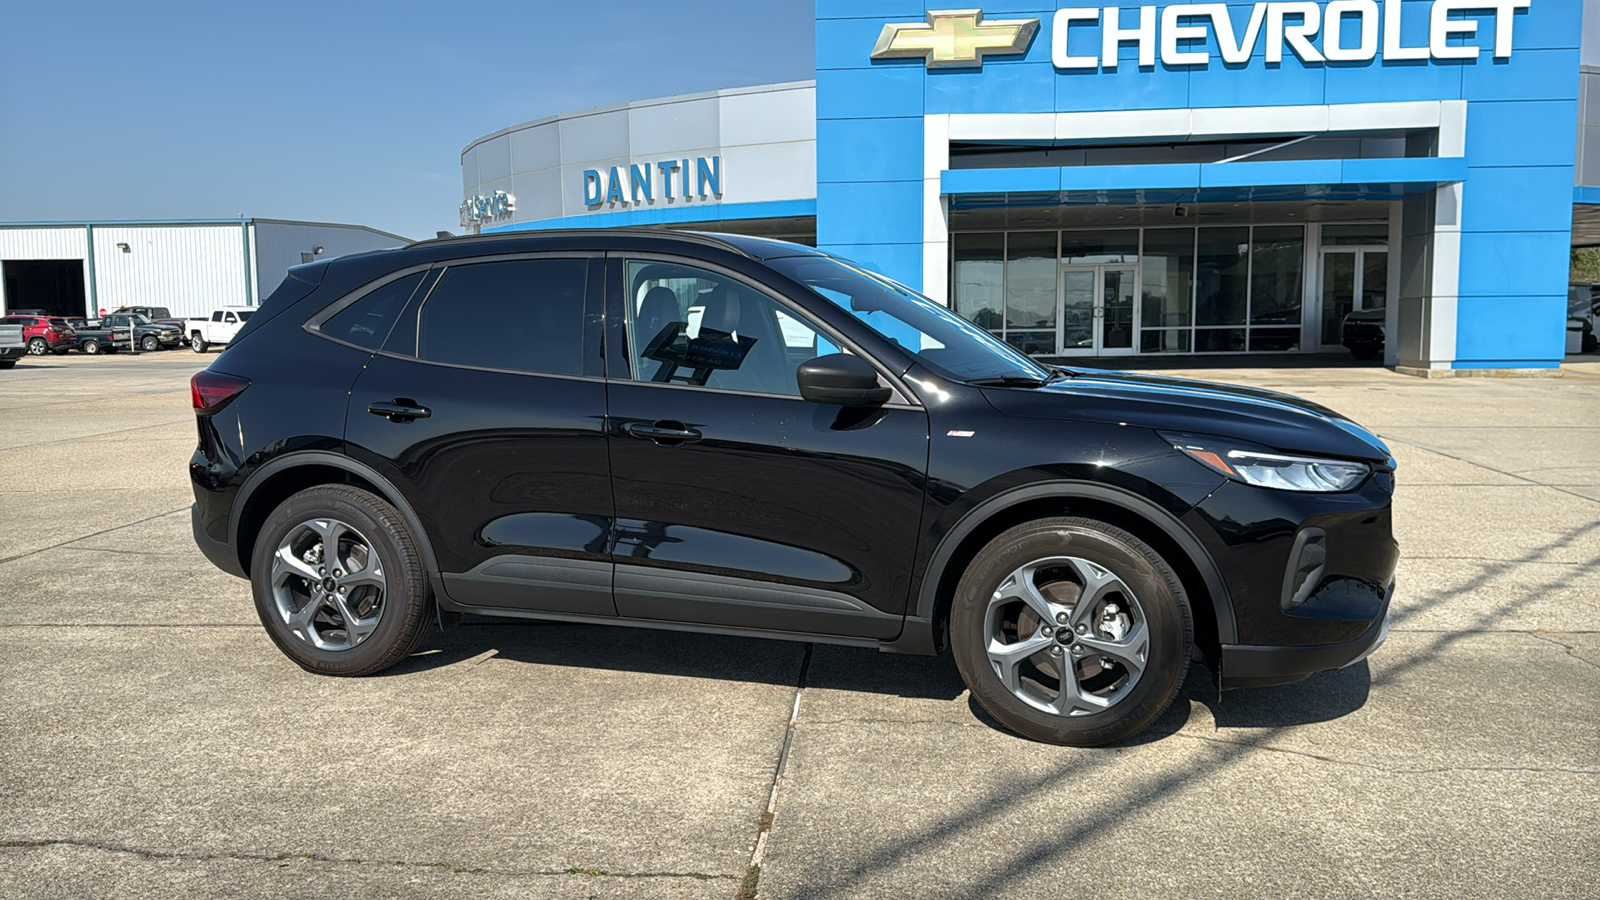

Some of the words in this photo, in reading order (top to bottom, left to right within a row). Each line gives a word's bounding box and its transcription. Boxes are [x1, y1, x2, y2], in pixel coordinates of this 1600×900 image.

[1052, 0, 1531, 69] CHEVROLET
[473, 190, 510, 219] Service
[583, 155, 720, 206] DANTIN
